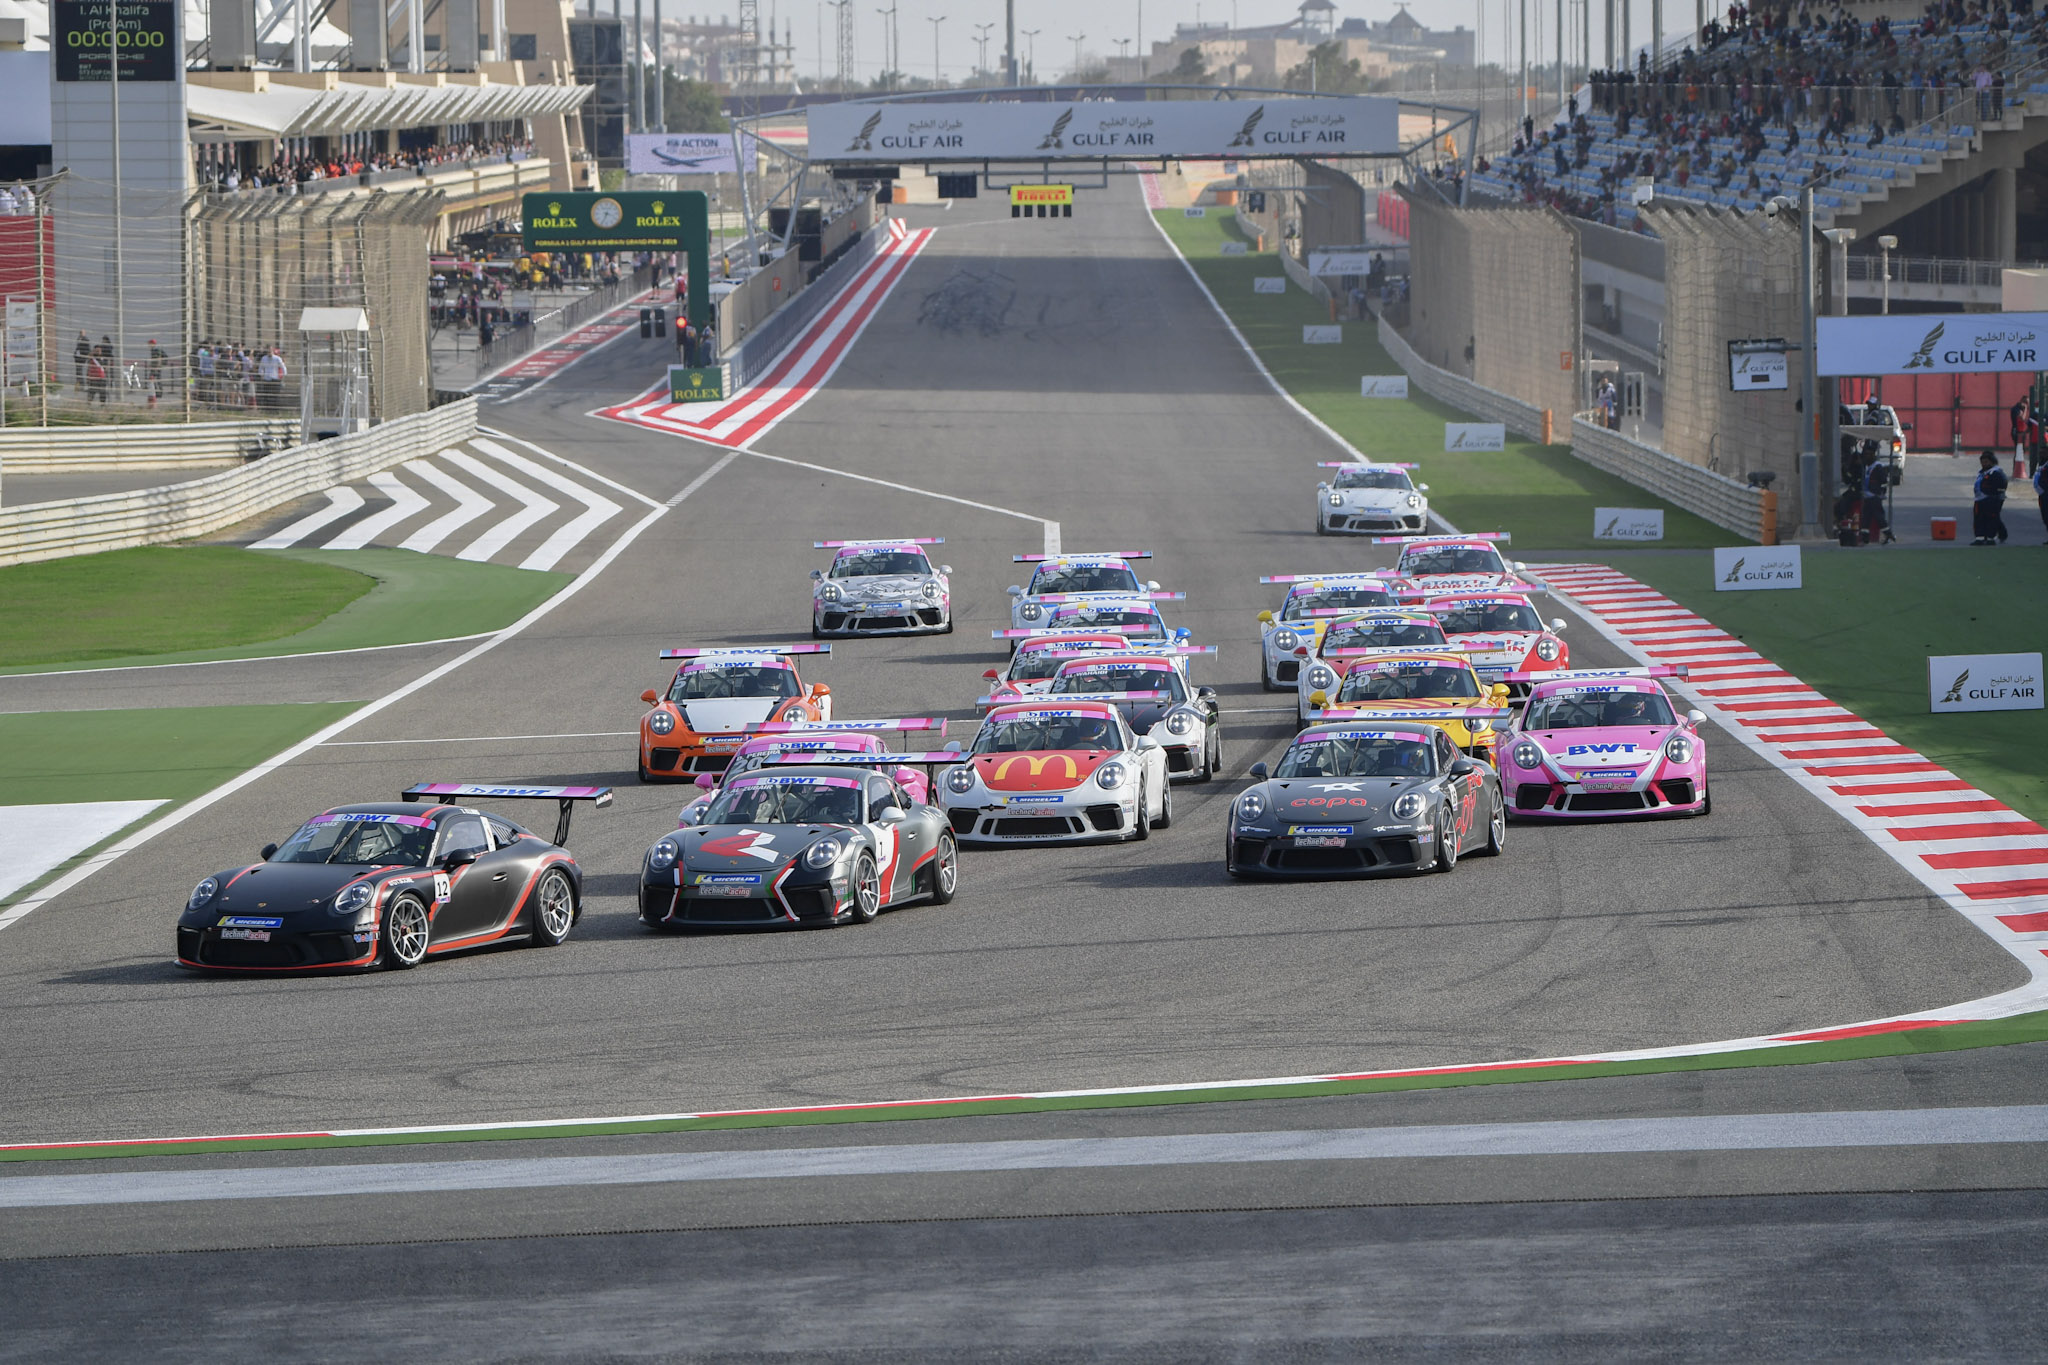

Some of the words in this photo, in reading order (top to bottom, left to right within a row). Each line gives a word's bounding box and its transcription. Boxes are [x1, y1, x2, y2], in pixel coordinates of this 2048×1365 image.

[881, 136, 930, 148] GULF
[933, 135, 963, 148] AIR
[1072, 134, 1118, 146] GULF
[1124, 133, 1154, 145] AIR
[1264, 132, 1311, 144] GULF
[1316, 130, 1345, 143] AIR
[682, 138, 718, 148] ACTION
[1017, 190, 1066, 200] PIRELLI
[532, 218, 578, 228] ROLEX
[636, 216, 680, 226] ROLEX
[1974, 332, 2006, 347] الخليج
[2008, 332, 2036, 343] طيران
[1944, 350, 1998, 364] GULF
[2002, 349, 2036, 363] AIR
[1618, 528, 1640, 536] GULF
[1744, 572, 1772, 581] GULF
[1776, 572, 1794, 580] AIR
[674, 676, 687, 689] 5
[1342, 675, 1371, 692] 50
[1990, 676, 2012, 687] الخليج
[2014, 675, 2034, 684] طيران
[1969, 688, 2007, 699] GULF
[2010, 688, 2034, 698] AIR
[980, 724, 1010, 741] 27
[1300, 741, 1330, 750] BESLER
[1568, 744, 1638, 756] BWT
[1284, 749, 1314, 766] 16
[730, 756, 764, 775] 20
[1290, 797, 1367, 808] copa
[438, 881, 448, 896] 12
